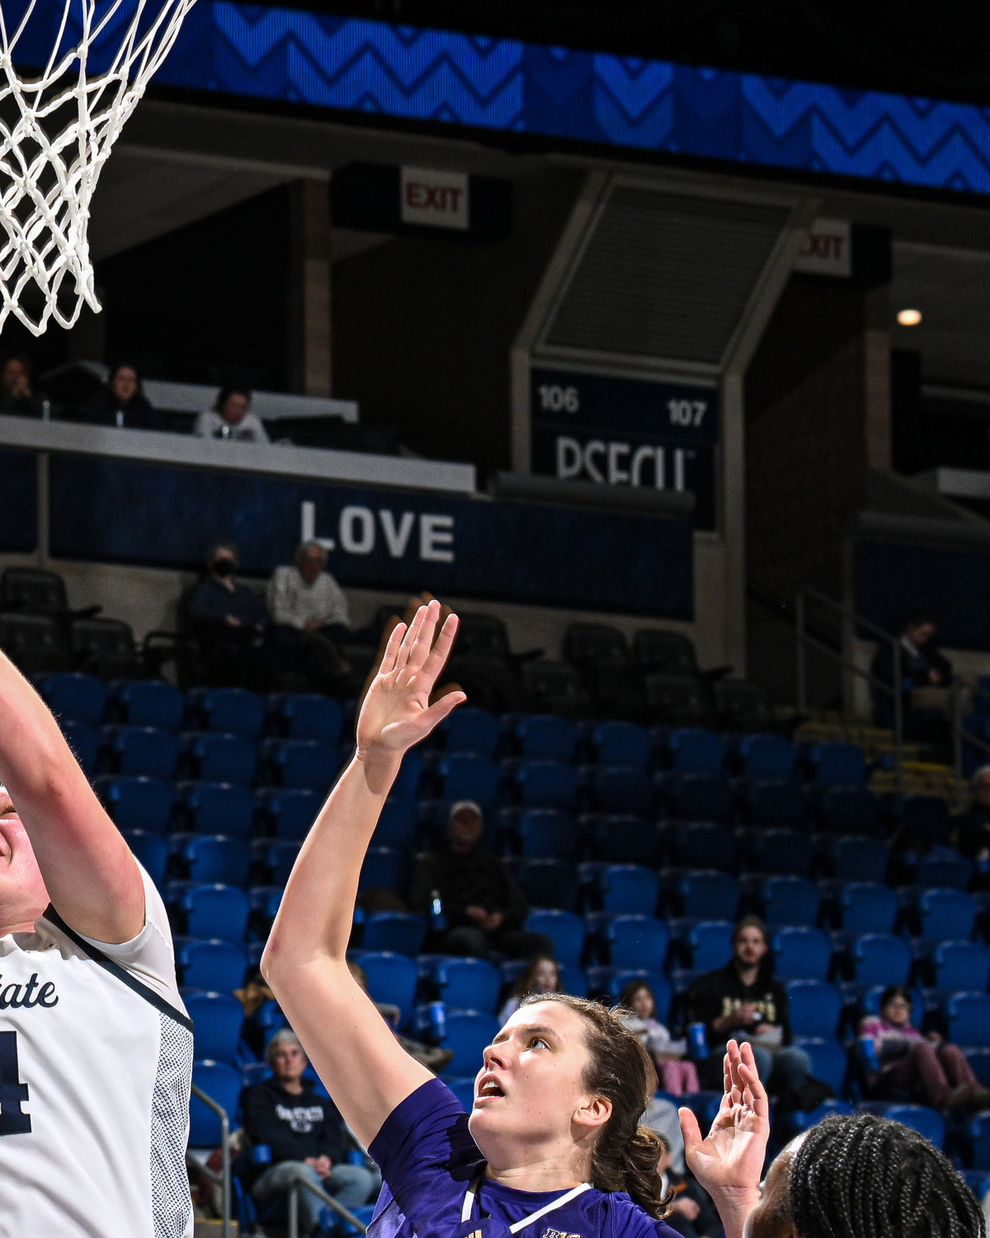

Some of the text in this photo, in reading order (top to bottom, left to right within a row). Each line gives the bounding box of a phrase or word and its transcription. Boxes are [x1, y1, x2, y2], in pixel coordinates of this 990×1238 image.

[406, 182, 463, 213] EXIT
[799, 233, 845, 258] XIT
[538, 384, 581, 415] 106
[665, 398, 708, 428] 107
[300, 500, 456, 565] LOVE
